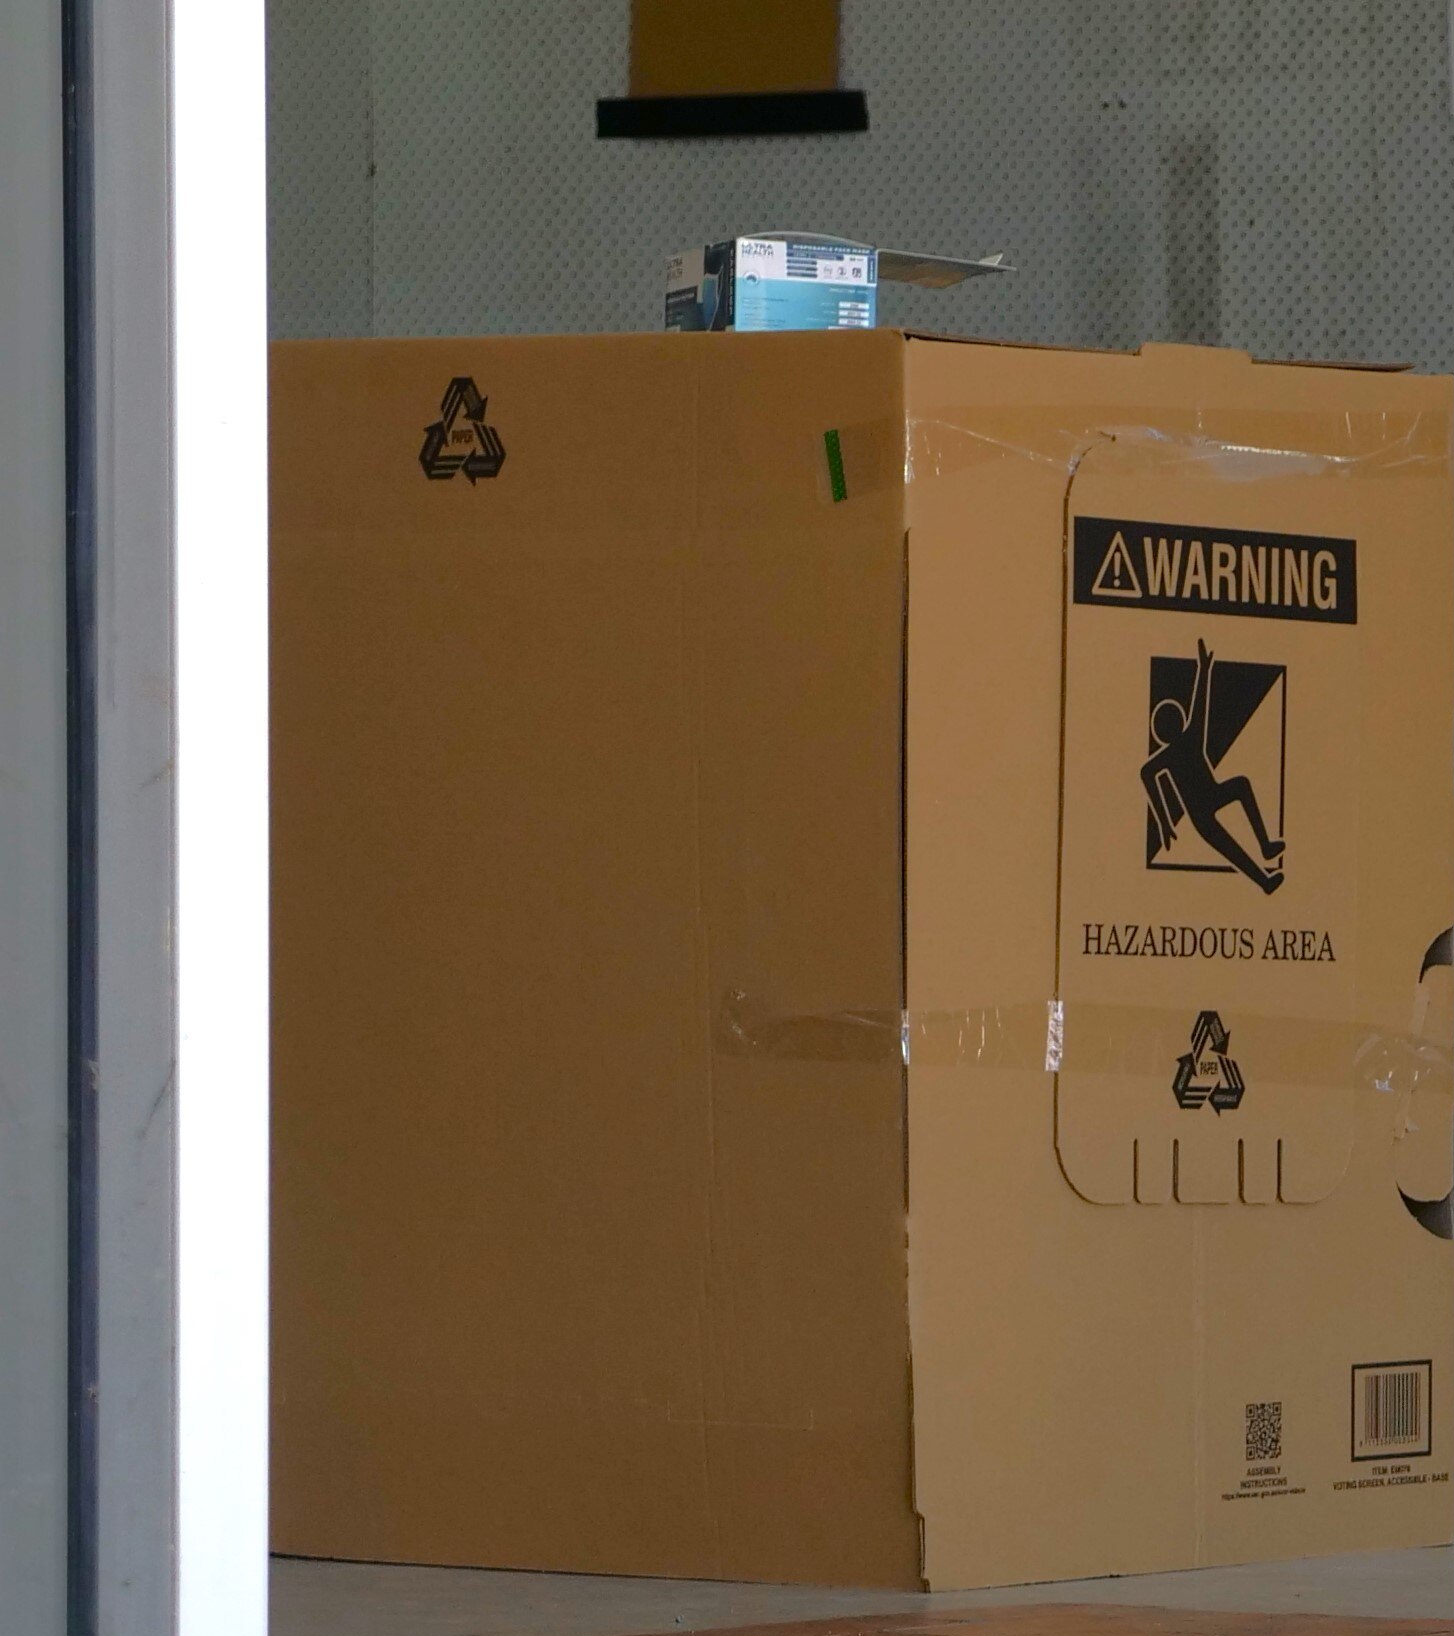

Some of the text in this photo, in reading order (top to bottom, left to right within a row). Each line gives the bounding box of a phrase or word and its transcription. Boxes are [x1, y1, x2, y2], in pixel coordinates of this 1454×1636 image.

[1143, 536, 1337, 610] WARNING
[1082, 923, 1337, 962] HAZARDOUS AREA
